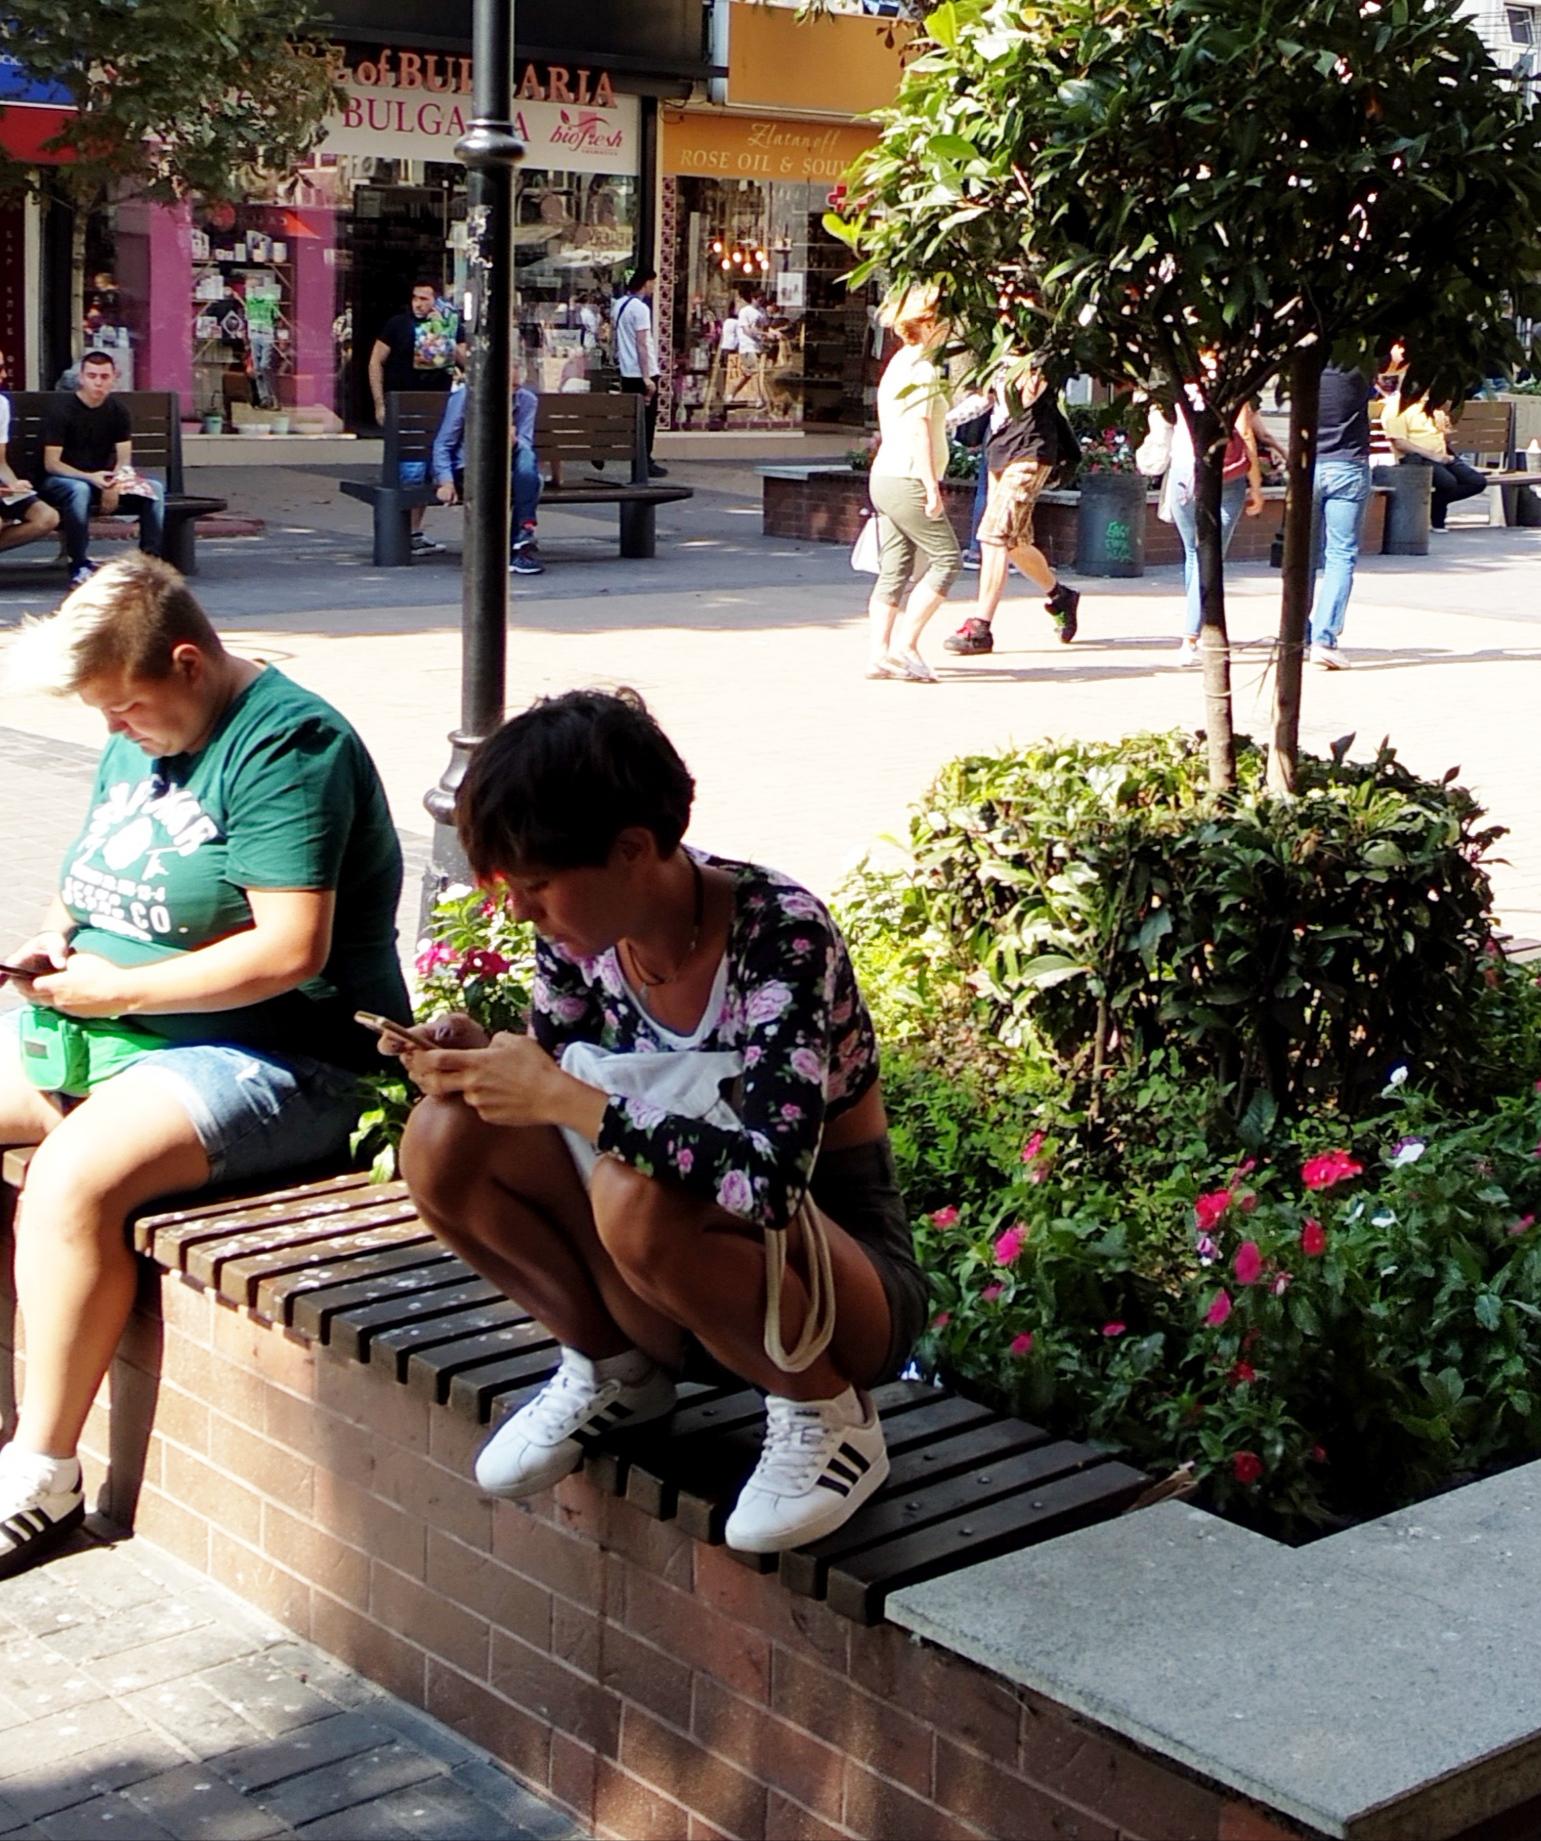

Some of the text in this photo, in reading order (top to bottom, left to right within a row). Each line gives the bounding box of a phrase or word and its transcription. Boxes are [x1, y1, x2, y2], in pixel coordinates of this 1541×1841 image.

[356, 49, 391, 86] of
[343, 97, 530, 142] BULGAA
[550, 125, 622, 152] biofresh
[680, 149, 730, 169] ROSE
[738, 153, 771, 172] OIL
[780, 156, 793, 173] &
